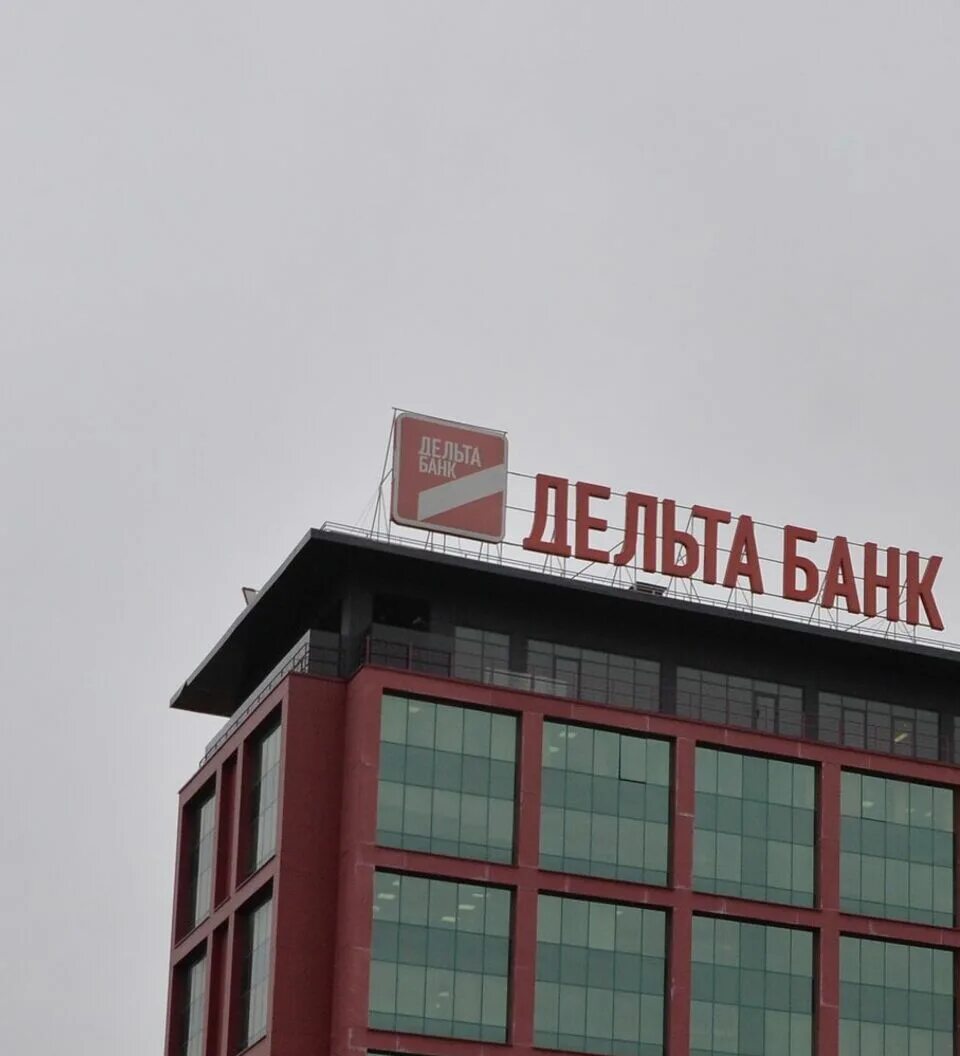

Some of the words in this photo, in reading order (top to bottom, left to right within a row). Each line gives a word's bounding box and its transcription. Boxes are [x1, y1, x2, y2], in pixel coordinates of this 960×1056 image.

[418, 436, 481, 467] ДЕЛЬТА
[419, 455, 457, 479] БАНК
[522, 473, 764, 595] ДЕЛЬТА
[782, 524, 944, 631] БАНК
